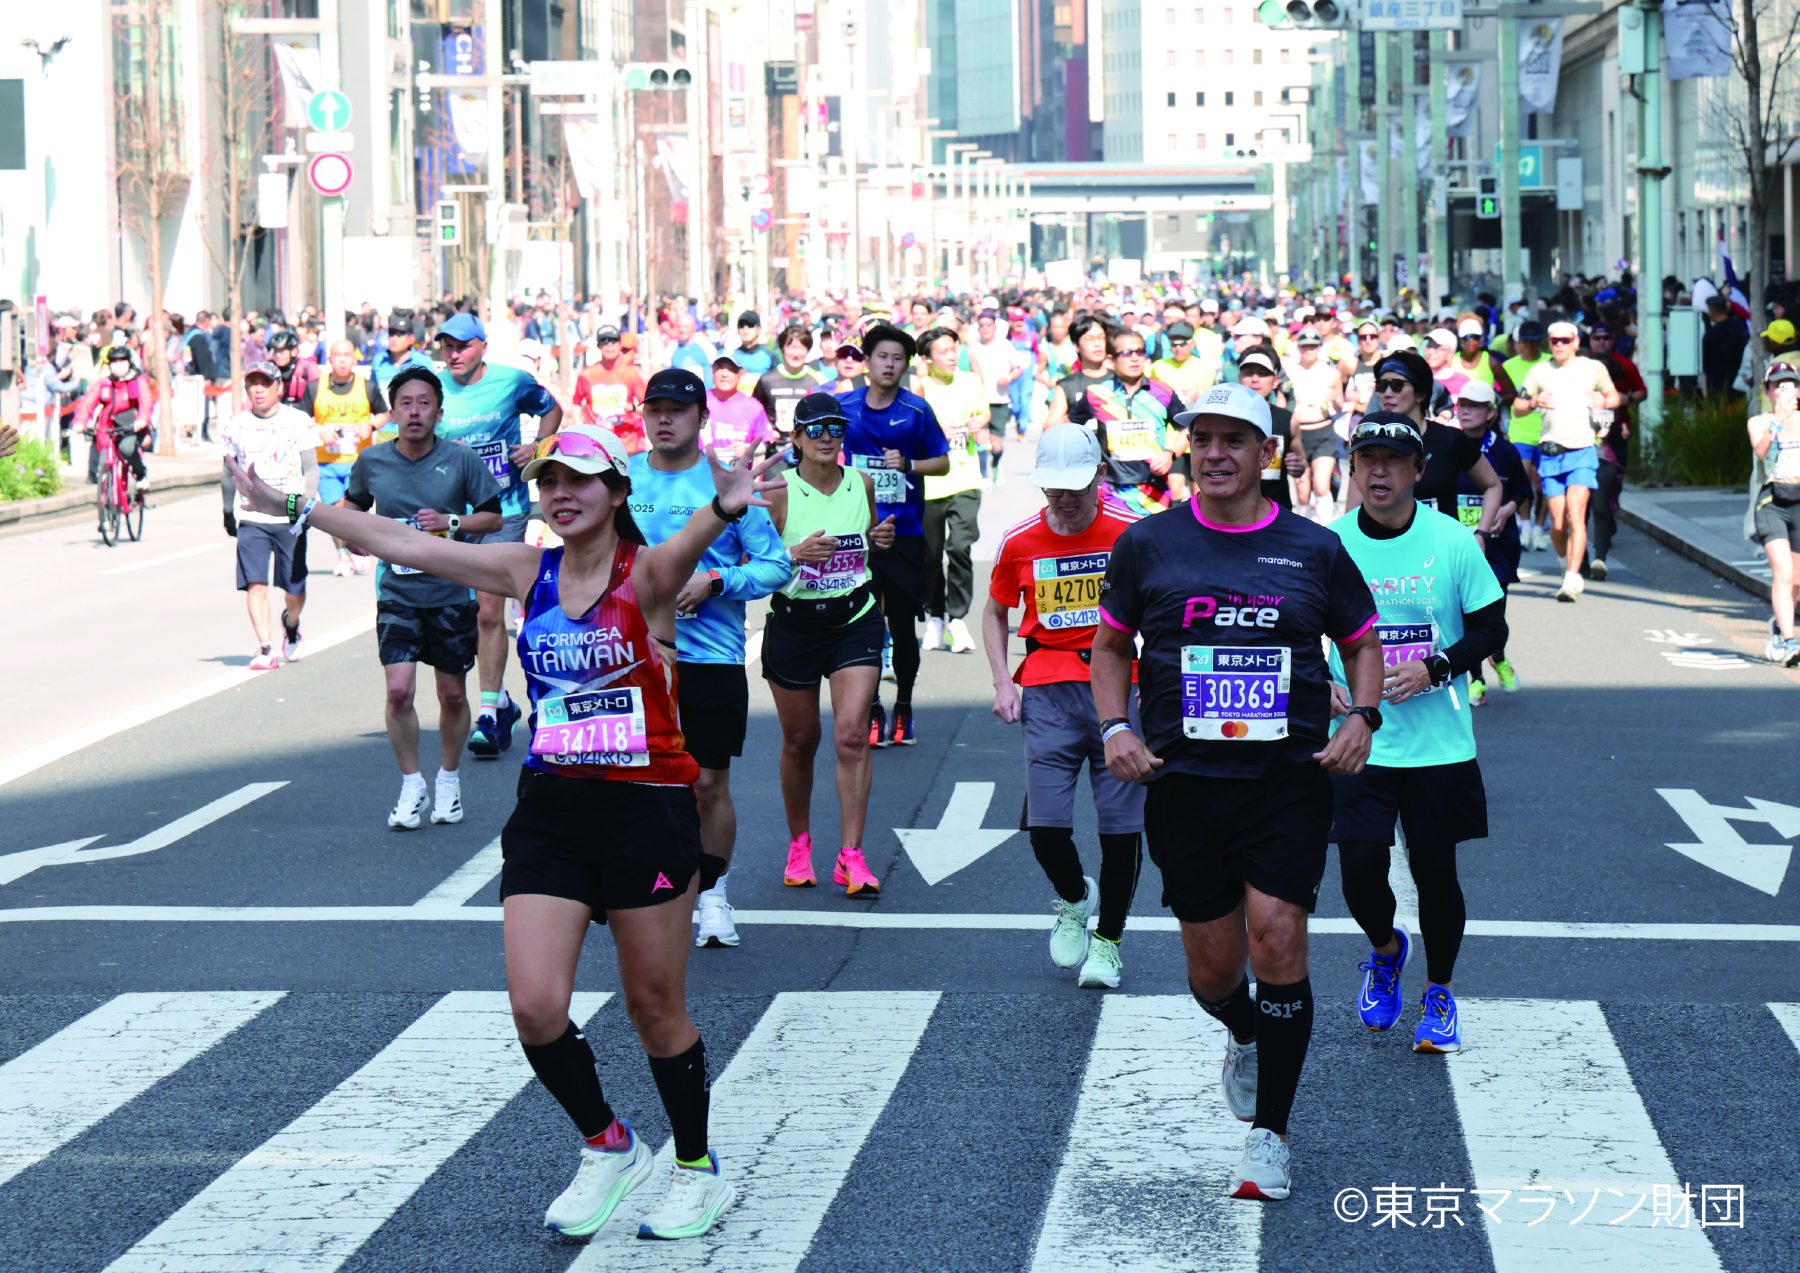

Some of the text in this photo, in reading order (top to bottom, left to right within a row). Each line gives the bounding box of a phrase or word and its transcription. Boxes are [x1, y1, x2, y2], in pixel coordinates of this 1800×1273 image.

[1060, 558, 1106, 572] 東京メトロ
[1257, 556, 1303, 568] marathon
[1039, 585, 1046, 599] J
[1369, 575, 1436, 596] ARITY
[1041, 604, 1047, 613] 5
[1228, 588, 1286, 615] in your
[1374, 597, 1414, 607] ARATHON
[1182, 596, 1280, 629] Pace
[535, 626, 622, 649] FORMOSA
[1378, 629, 1429, 641] 東京メトロ
[527, 641, 635, 674] TAIWAN
[1218, 654, 1278, 668] 東京メトロ
[1186, 681, 1197, 697] E
[1205, 678, 1275, 709] 30369
[568, 696, 628, 715] 東京メトロ
[1188, 704, 1196, 717] 2
[537, 733, 551, 749] F
[558, 722, 628, 755] 34718
